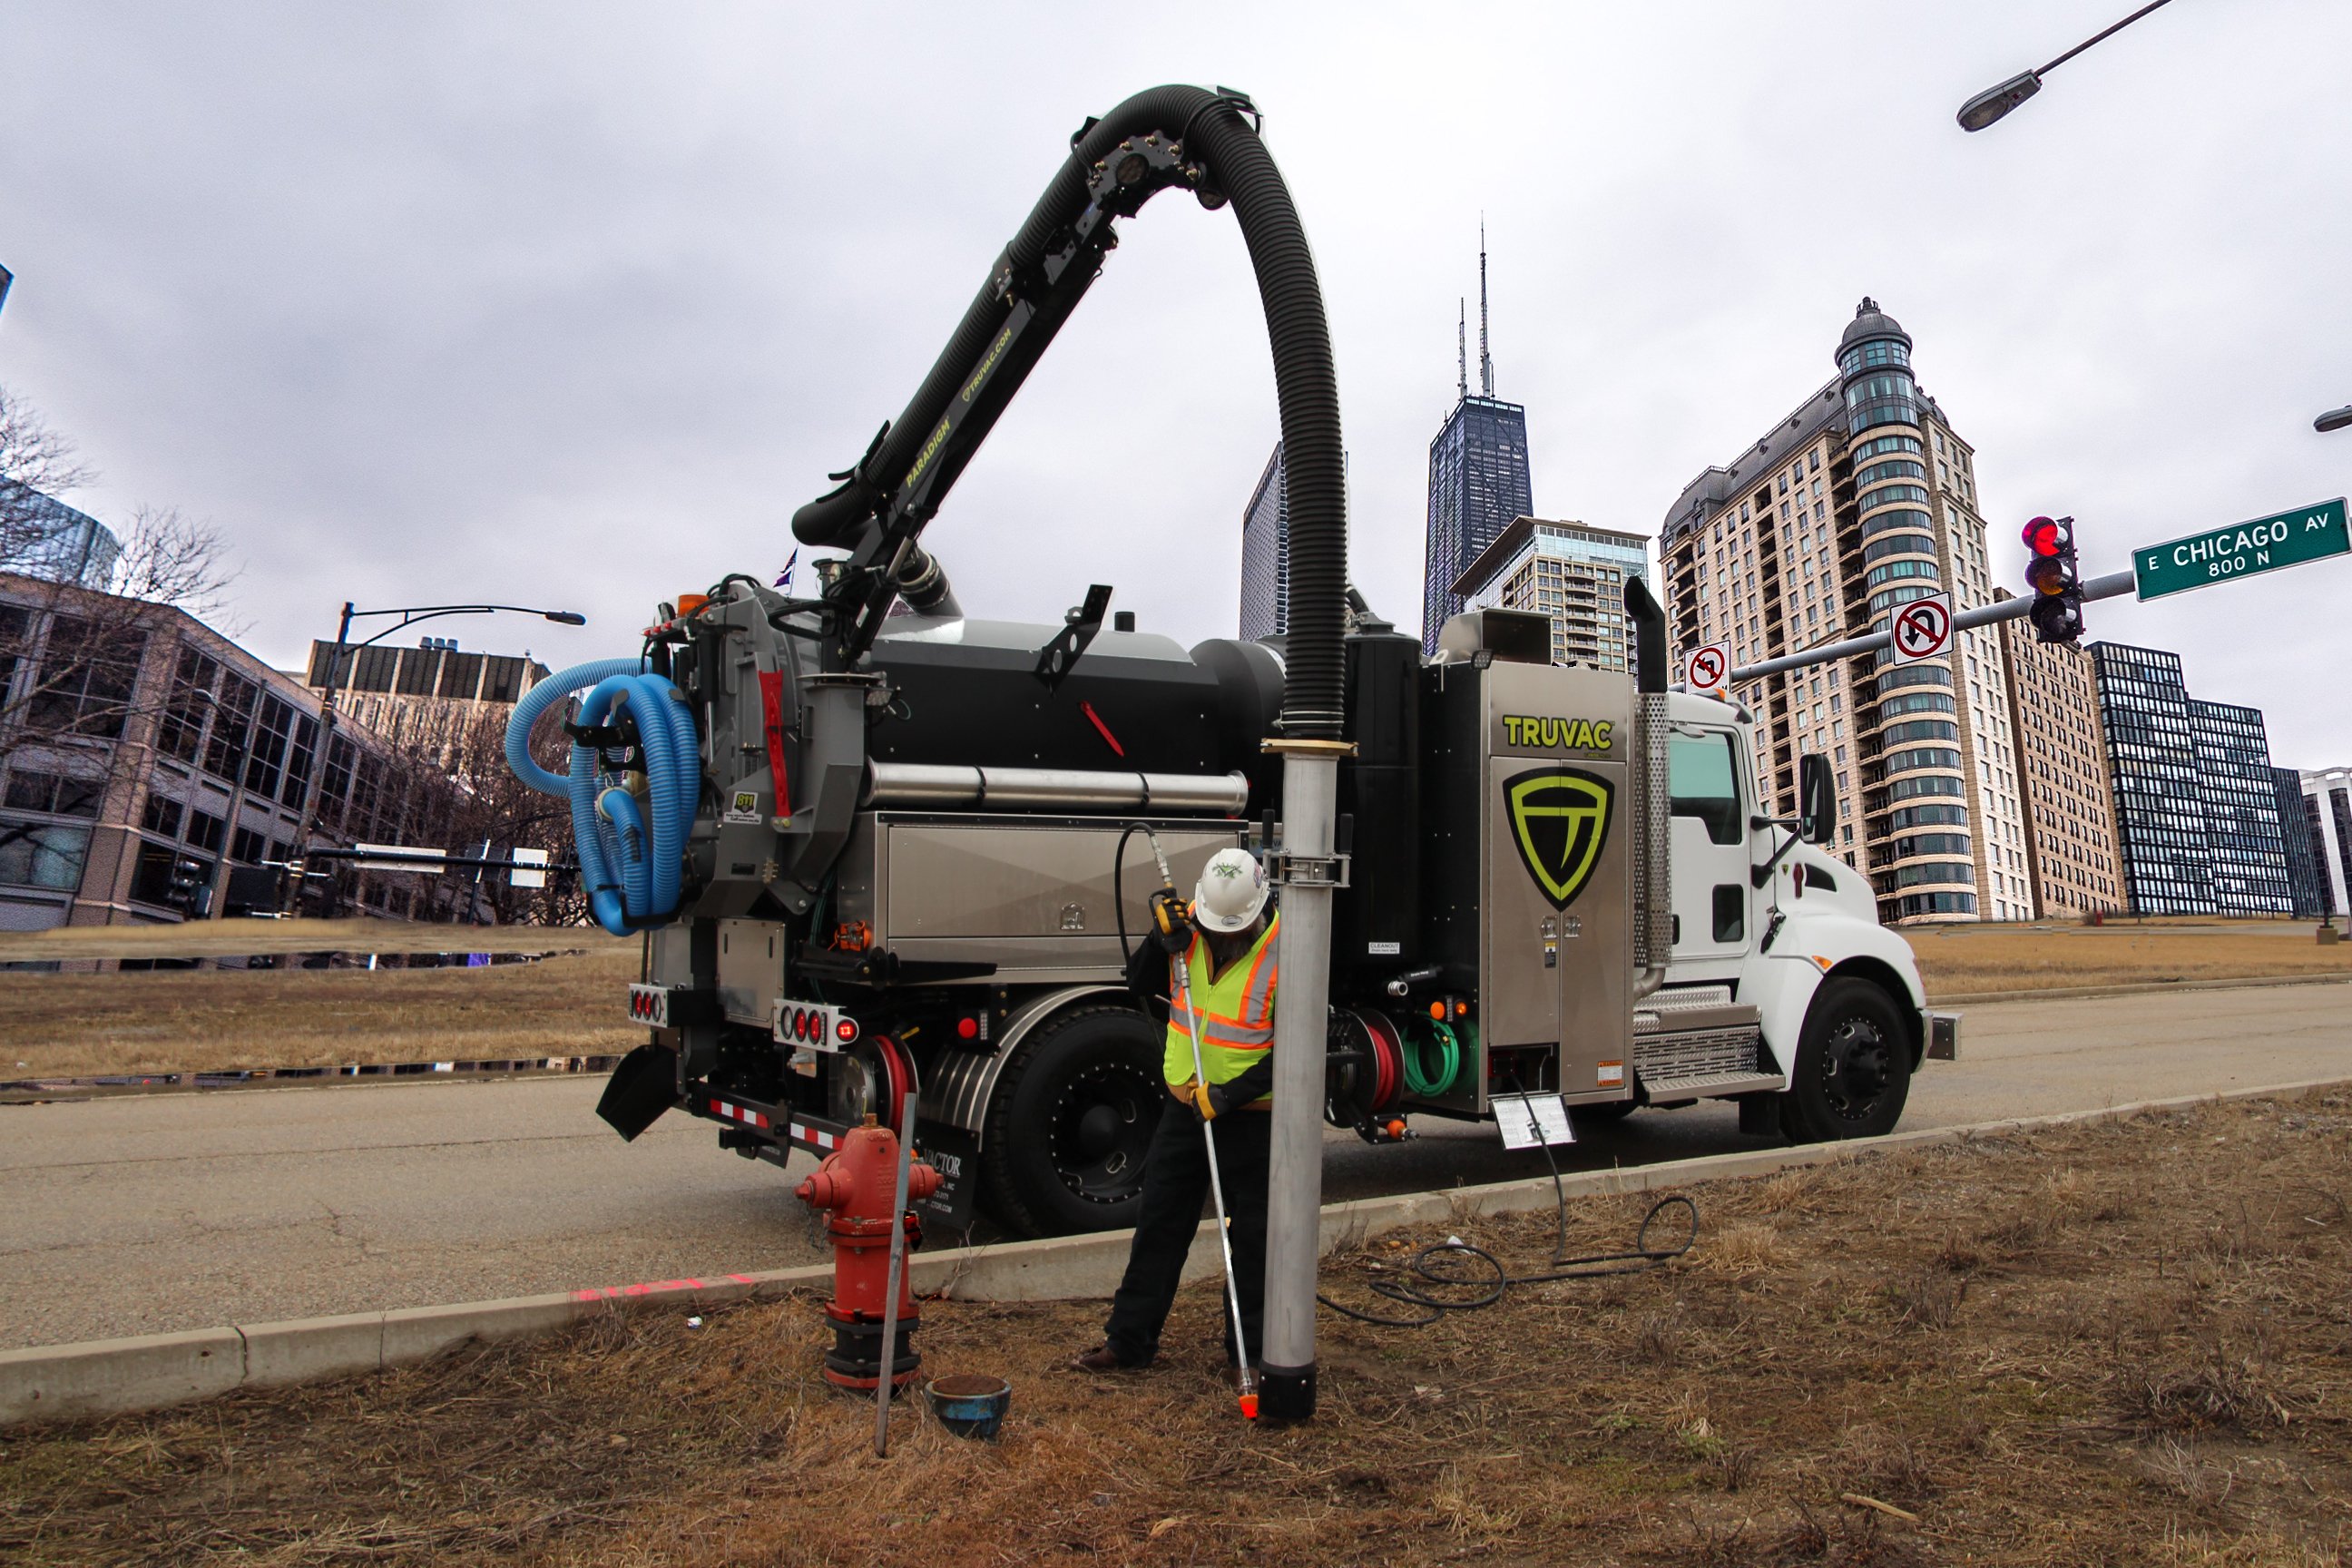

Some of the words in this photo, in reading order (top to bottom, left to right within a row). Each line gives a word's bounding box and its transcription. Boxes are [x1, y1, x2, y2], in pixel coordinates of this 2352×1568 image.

[969, 328, 1012, 394] TRUVAC.COM
[906, 418, 951, 488] PARADIGM
[2149, 555, 2160, 571] E
[2173, 521, 2288, 566] CHICAGO
[2305, 513, 2329, 532] AV
[2208, 555, 2246, 577] 800
[2257, 550, 2269, 565] N
[1503, 715, 1612, 750] TRUVAC
[737, 794, 754, 807] 811
[924, 1149, 962, 1176] VACTOR
